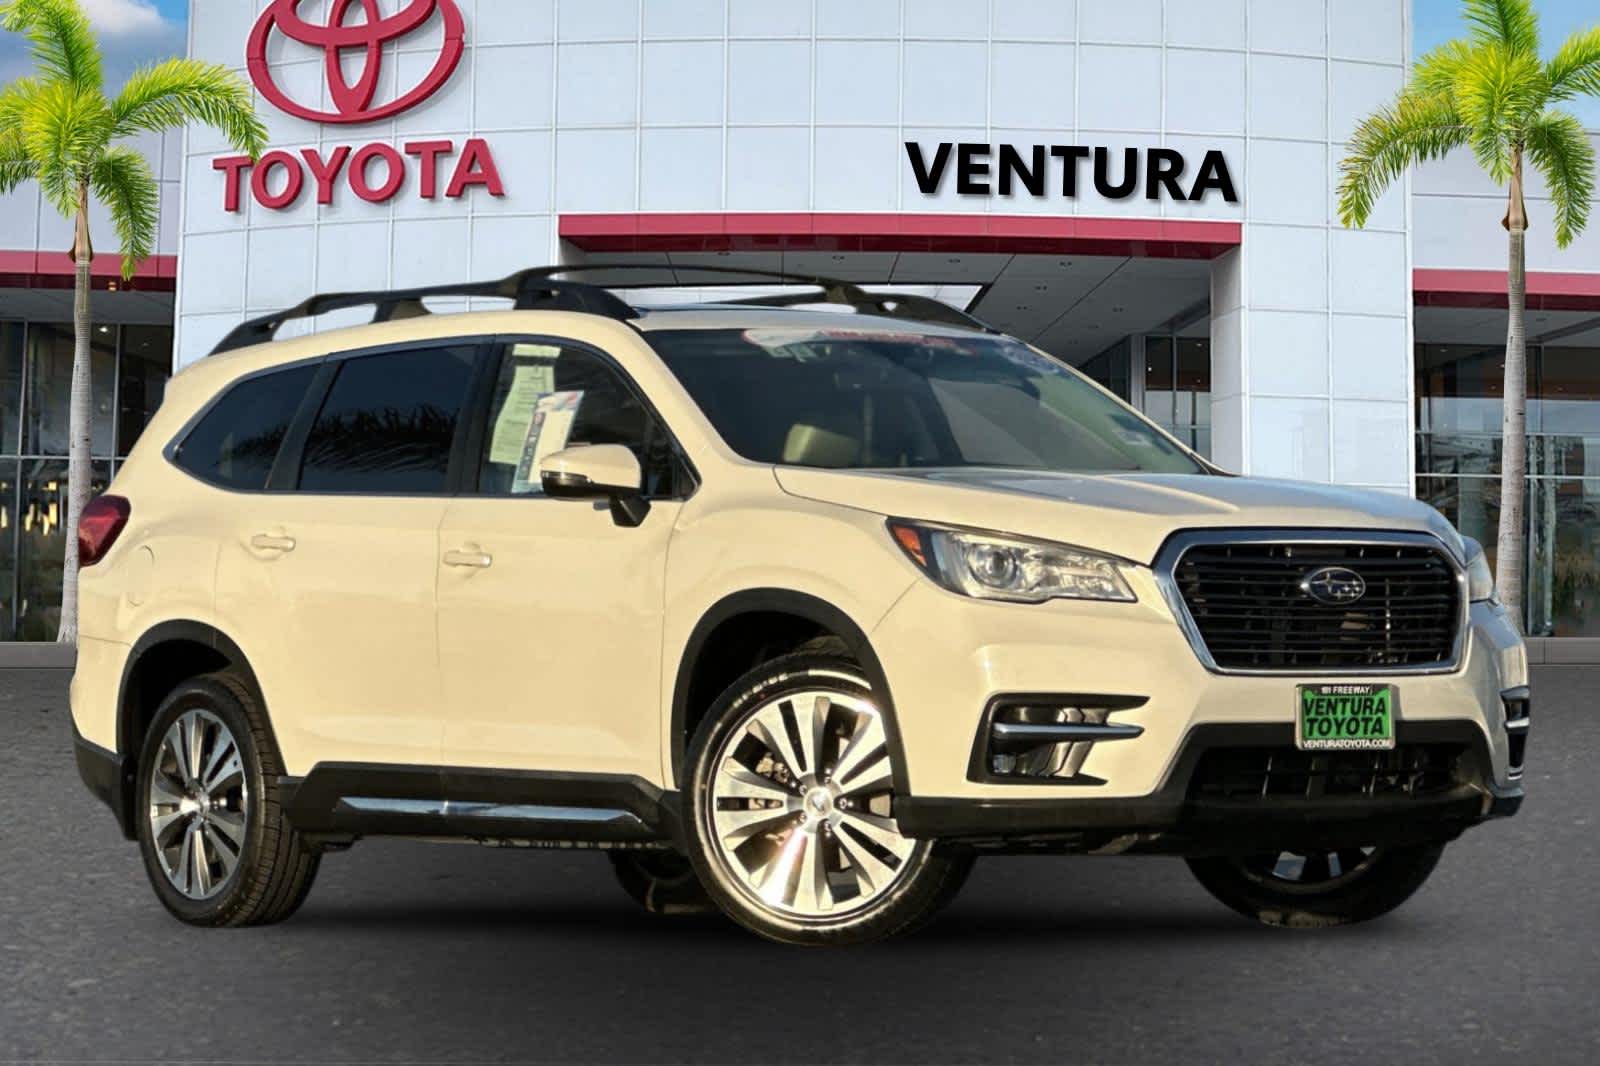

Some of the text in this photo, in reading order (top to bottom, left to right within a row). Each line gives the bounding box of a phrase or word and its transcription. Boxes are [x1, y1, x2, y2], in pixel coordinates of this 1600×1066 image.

[213, 139, 504, 211] TOYOTA
[905, 142, 1237, 202] VENTURA
[1332, 686, 1370, 694] FREEWAY
[1304, 698, 1386, 716] VENTURA
[1306, 718, 1384, 736] TOYOTA
